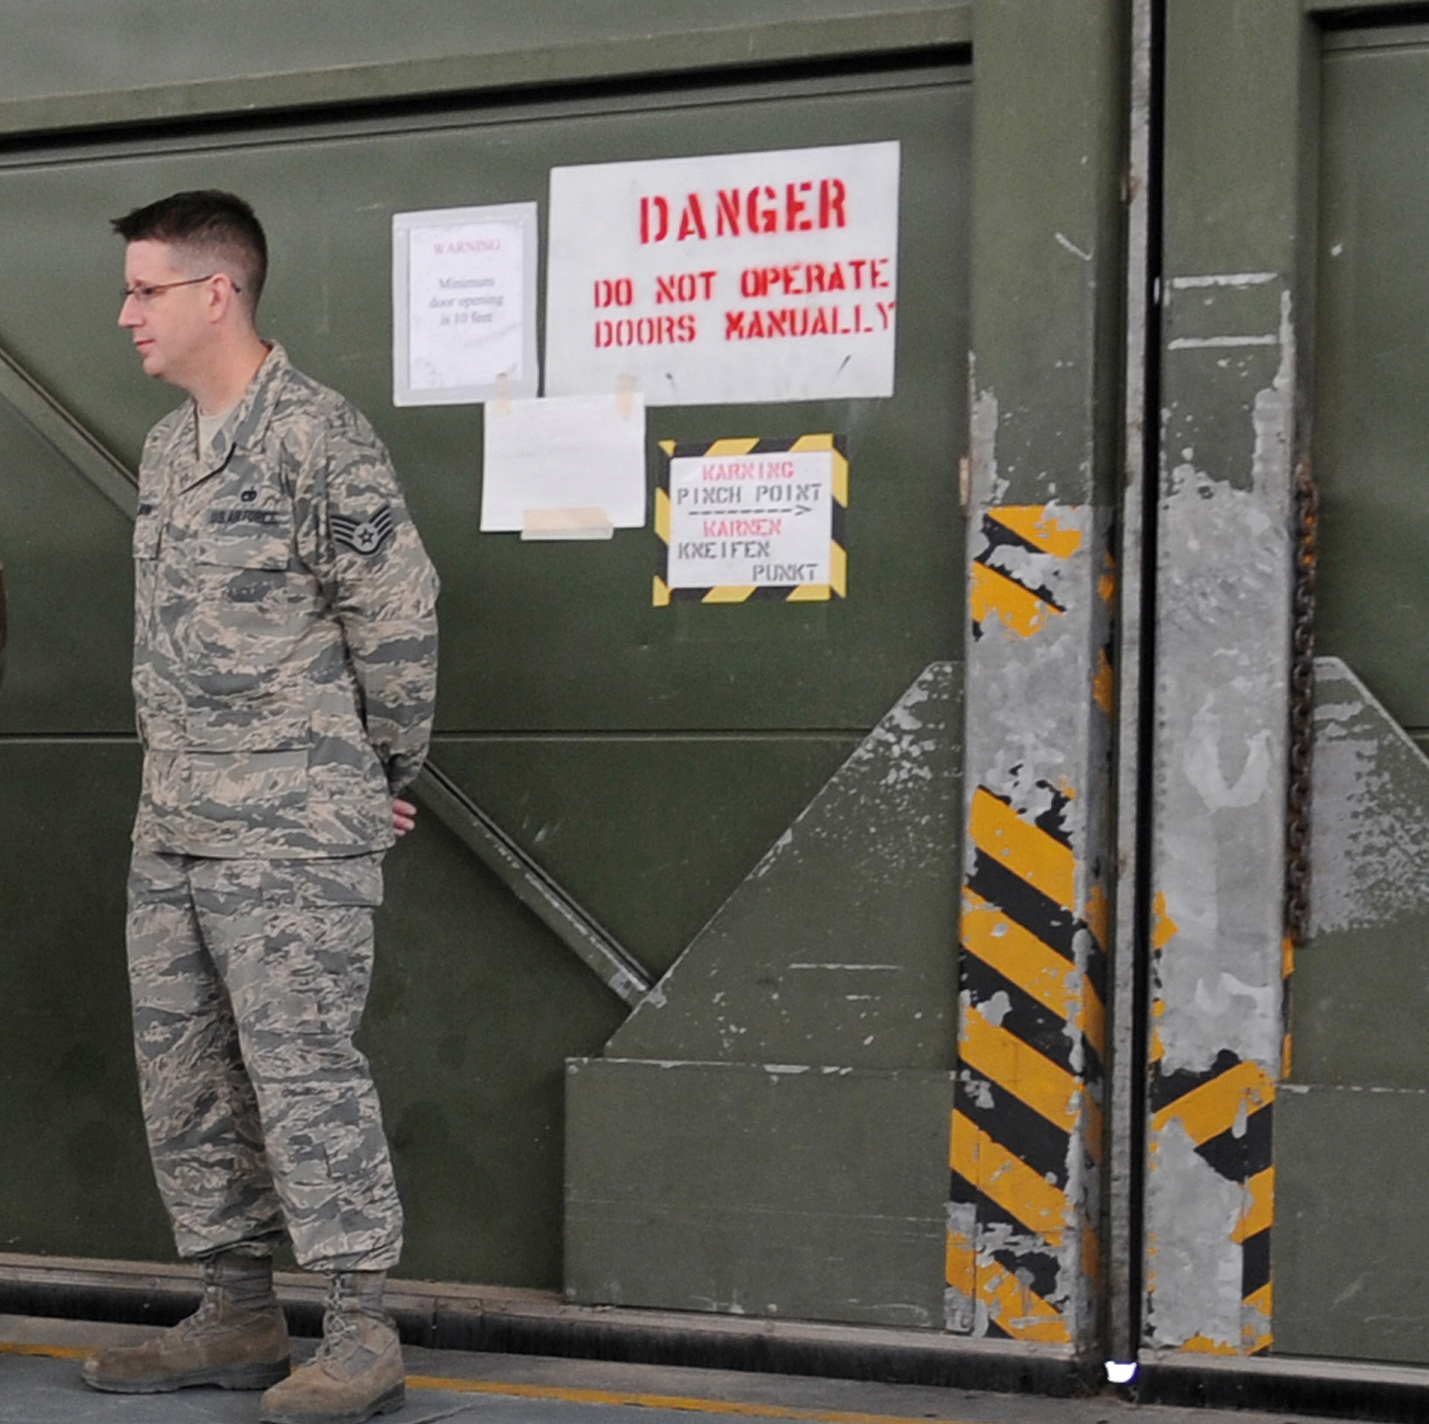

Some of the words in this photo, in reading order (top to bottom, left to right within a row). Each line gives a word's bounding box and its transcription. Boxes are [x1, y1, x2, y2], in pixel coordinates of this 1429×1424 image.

[641, 178, 846, 244] DANGER
[433, 240, 500, 254] WARNING
[594, 279, 632, 308] DO
[656, 271, 717, 304] NOT
[741, 258, 889, 298] OPERATE
[429, 297, 455, 308] door
[595, 315, 696, 348] DOORS
[725, 302, 896, 340] MANUALLY
[677, 486, 741, 505] PINCH
[756, 483, 822, 502] POINT
[678, 541, 770, 559] KNEIFEN
[752, 563, 818, 581] PUNKT
